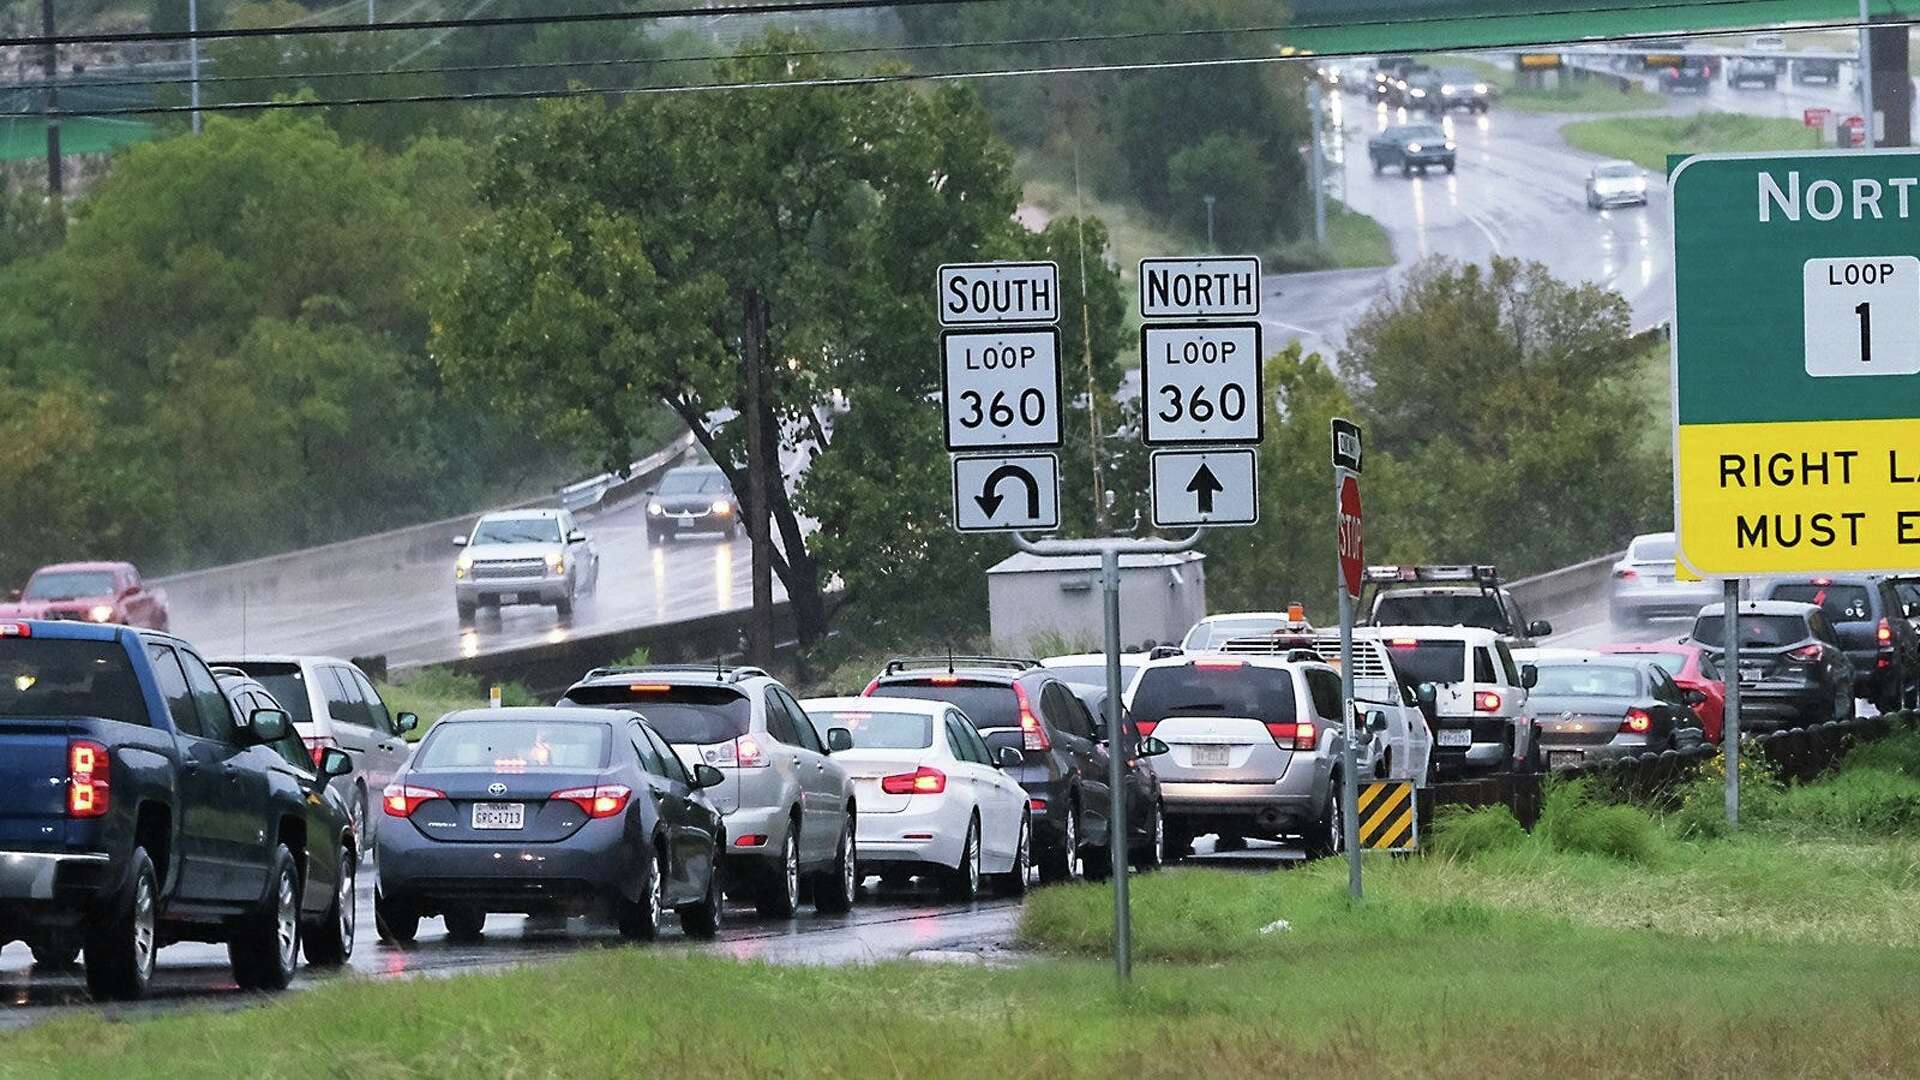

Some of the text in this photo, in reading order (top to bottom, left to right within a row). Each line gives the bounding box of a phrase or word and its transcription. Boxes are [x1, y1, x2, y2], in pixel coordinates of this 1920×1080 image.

[1148, 269, 1252, 307] NORTH
[1829, 264, 1894, 285] LOOP
[948, 275, 1050, 314] SOUTH
[1855, 302, 1871, 362] 1
[966, 346, 1036, 370] LOOP
[1166, 341, 1236, 365] LOOP
[959, 387, 1045, 428] 360
[1158, 383, 1246, 423] 360
[1719, 450, 1920, 488] RIGHT L
[1339, 514, 1361, 559] STOP
[1737, 512, 1866, 549] MUST
